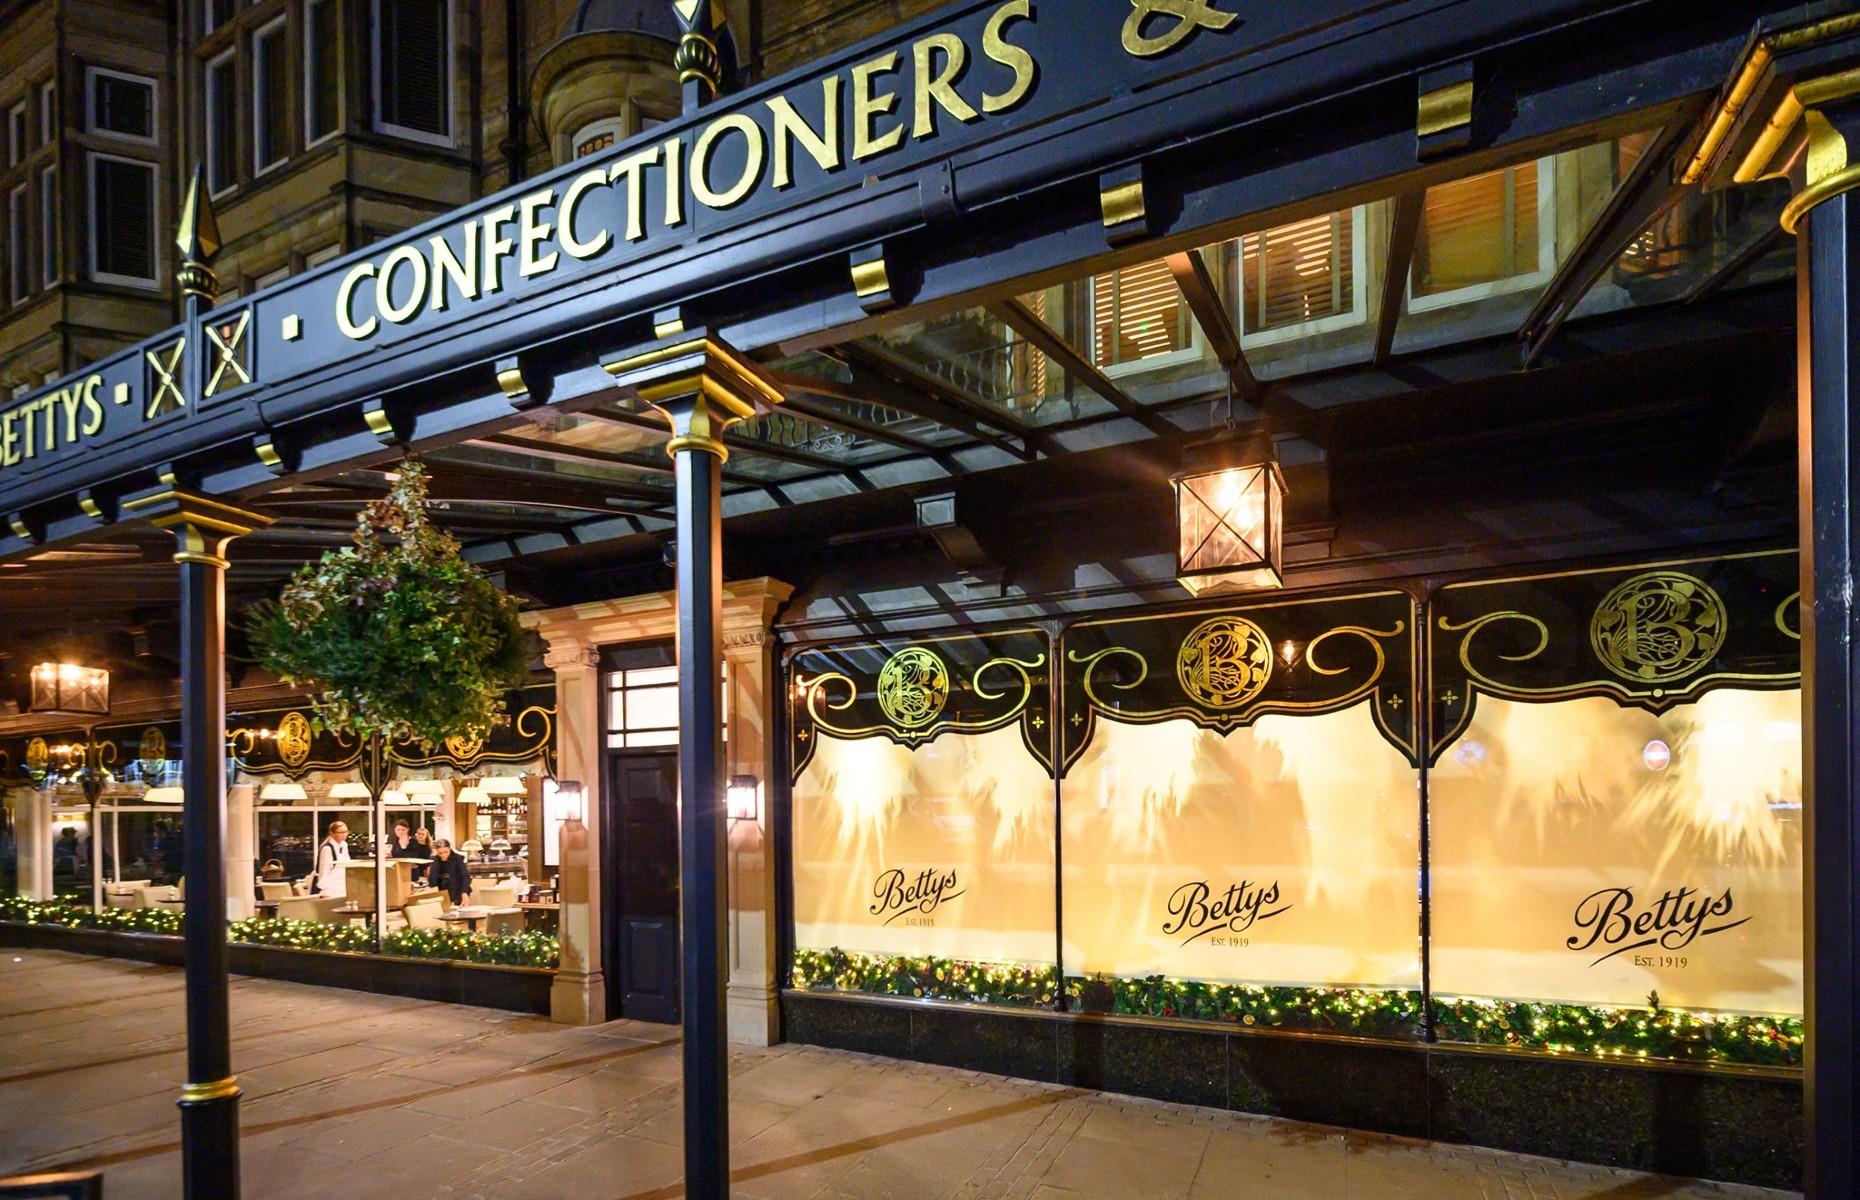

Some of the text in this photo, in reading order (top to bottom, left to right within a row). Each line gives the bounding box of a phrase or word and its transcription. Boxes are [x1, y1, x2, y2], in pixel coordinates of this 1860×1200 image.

[336, 0, 1033, 339] CONFECTIONERS
[0, 374, 103, 467] ETTYS
[870, 867, 957, 915] Bettys
[1162, 879, 1280, 935] Bettys
[919, 917, 935, 927] 1919
[1229, 937, 1249, 948] 1919
[1566, 886, 1733, 951] Bettys
[1659, 956, 1688, 969] 1919
